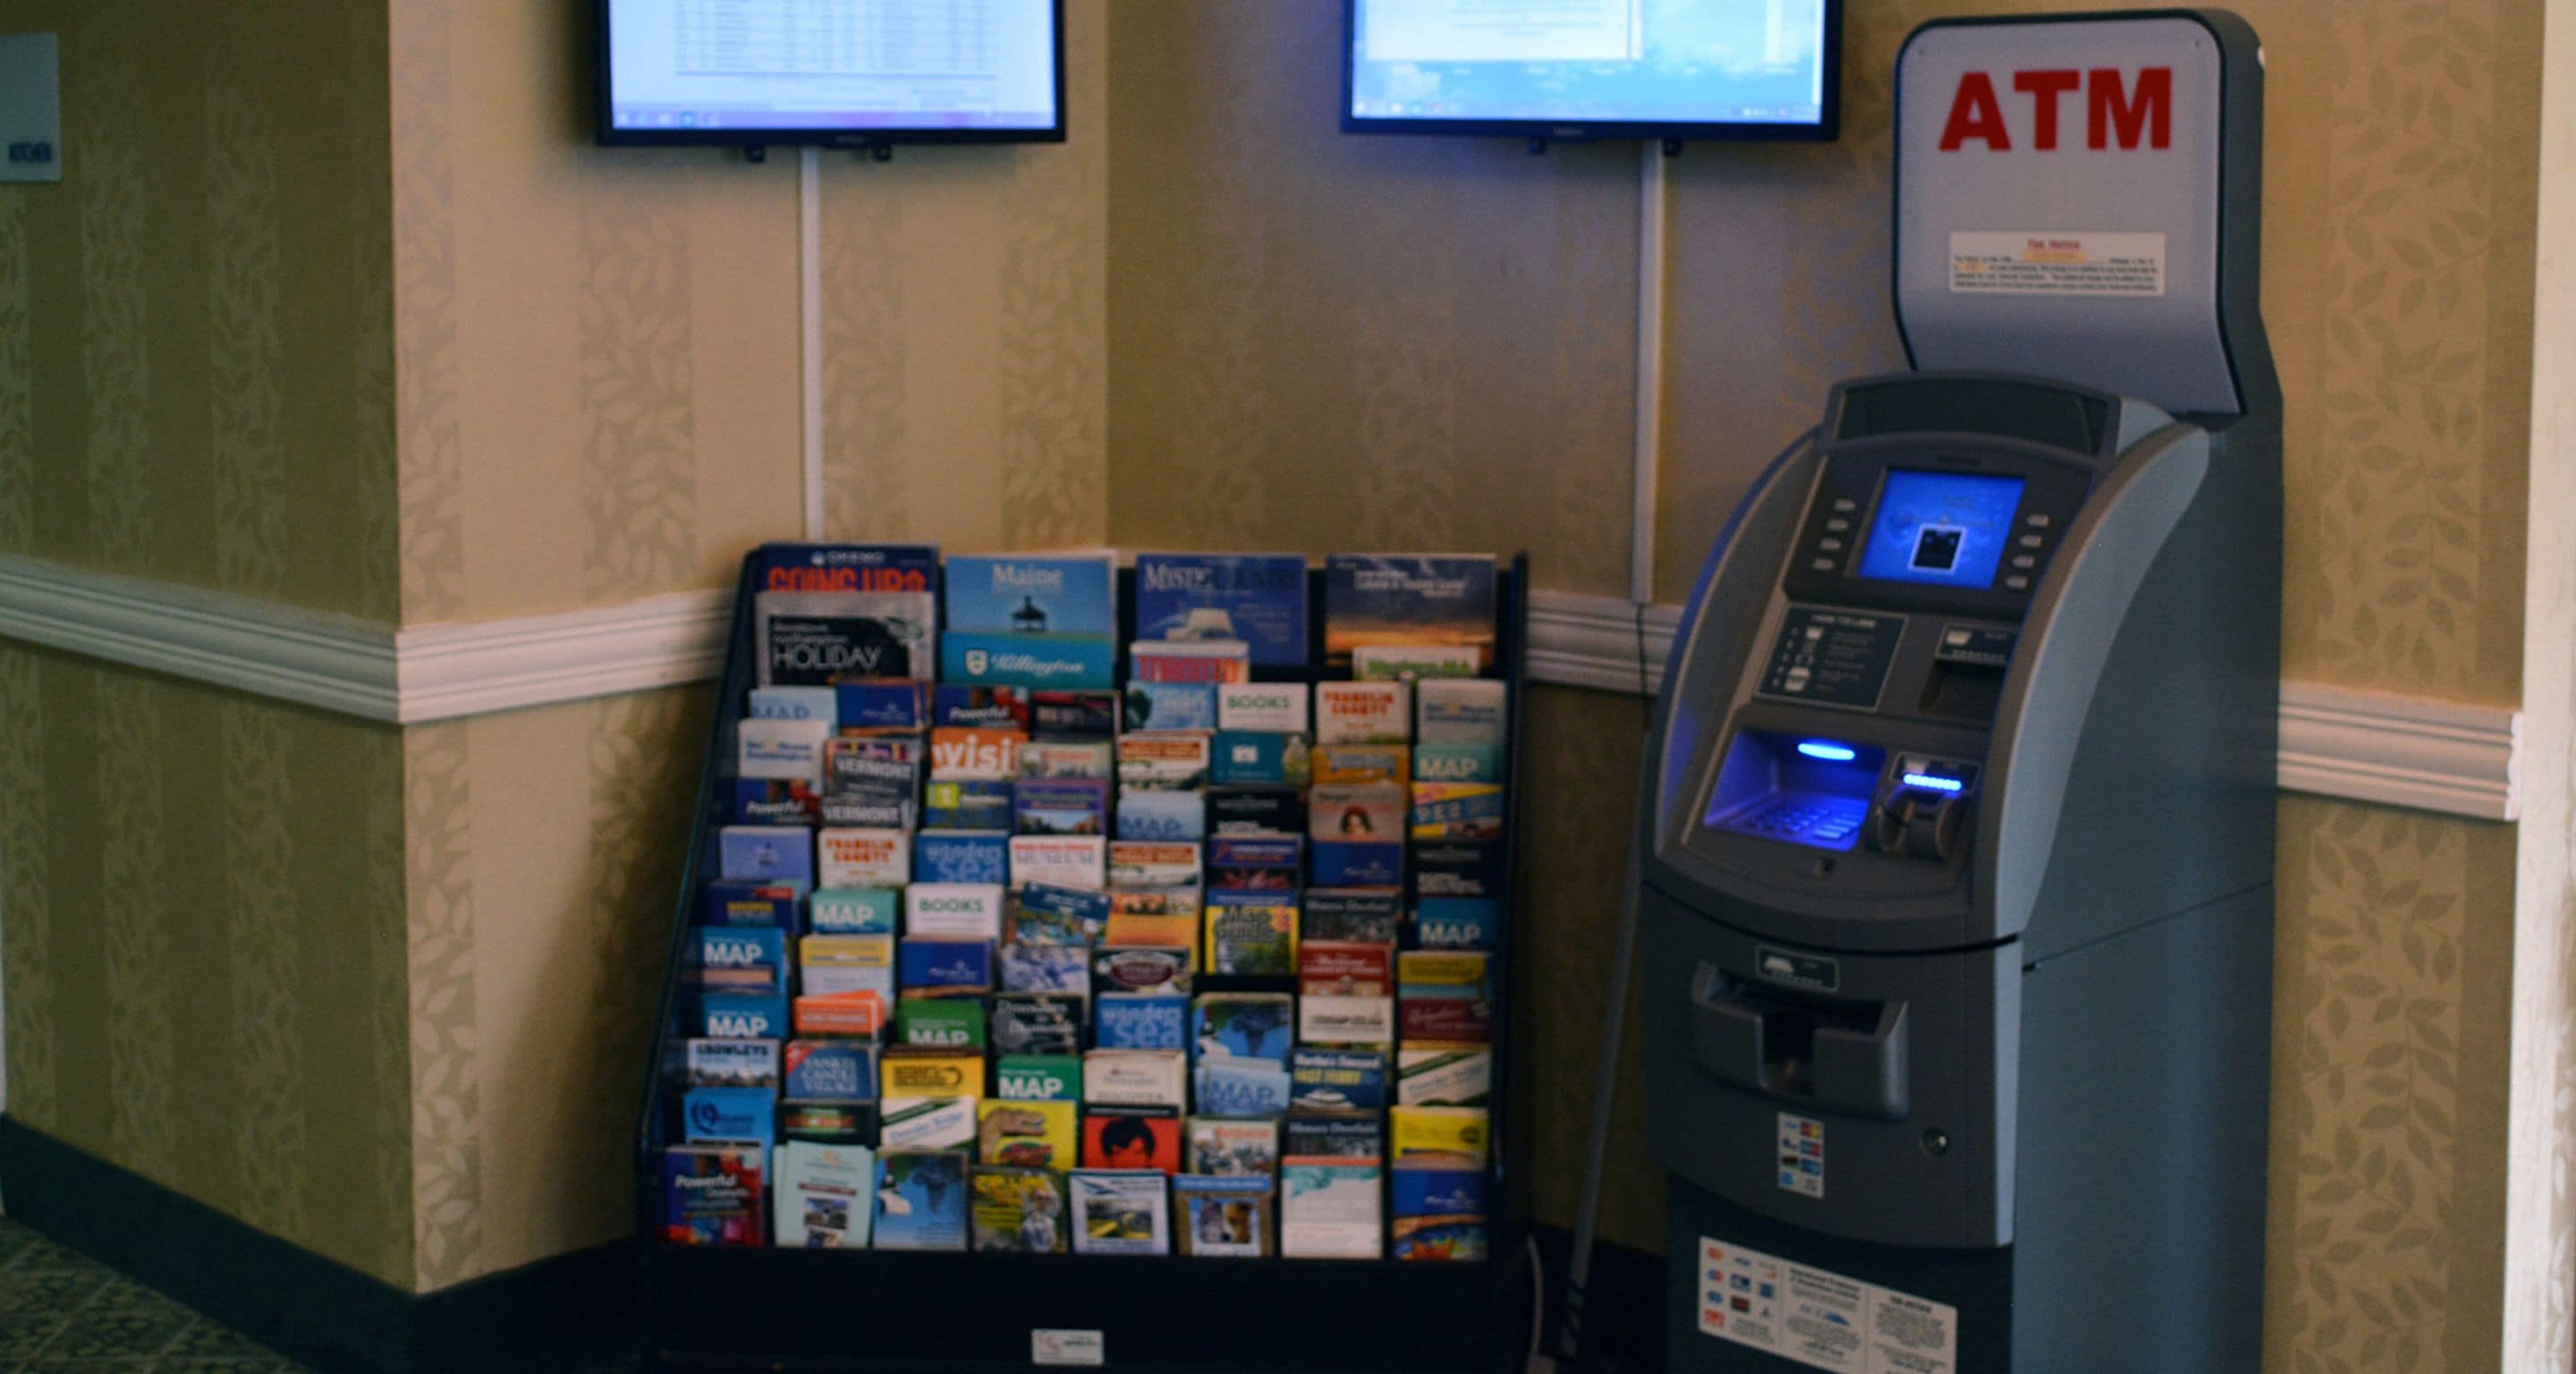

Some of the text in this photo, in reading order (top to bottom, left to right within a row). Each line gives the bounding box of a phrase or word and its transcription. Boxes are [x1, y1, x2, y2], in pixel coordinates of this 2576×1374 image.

[1939, 68, 2171, 150] ATM
[993, 564, 1063, 587] Maine
[773, 643, 882, 670] HOLIDAY
[1227, 695, 1290, 709] BOOKS
[1419, 758, 1479, 778] MAP
[815, 903, 875, 925] MAP
[919, 899, 982, 912] BOOKS
[1420, 924, 1481, 944] MAP
[704, 943, 763, 963] MAP
[708, 1016, 768, 1037] MAP
[909, 1029, 970, 1045] MAP
[998, 1077, 1063, 1098] MAP
